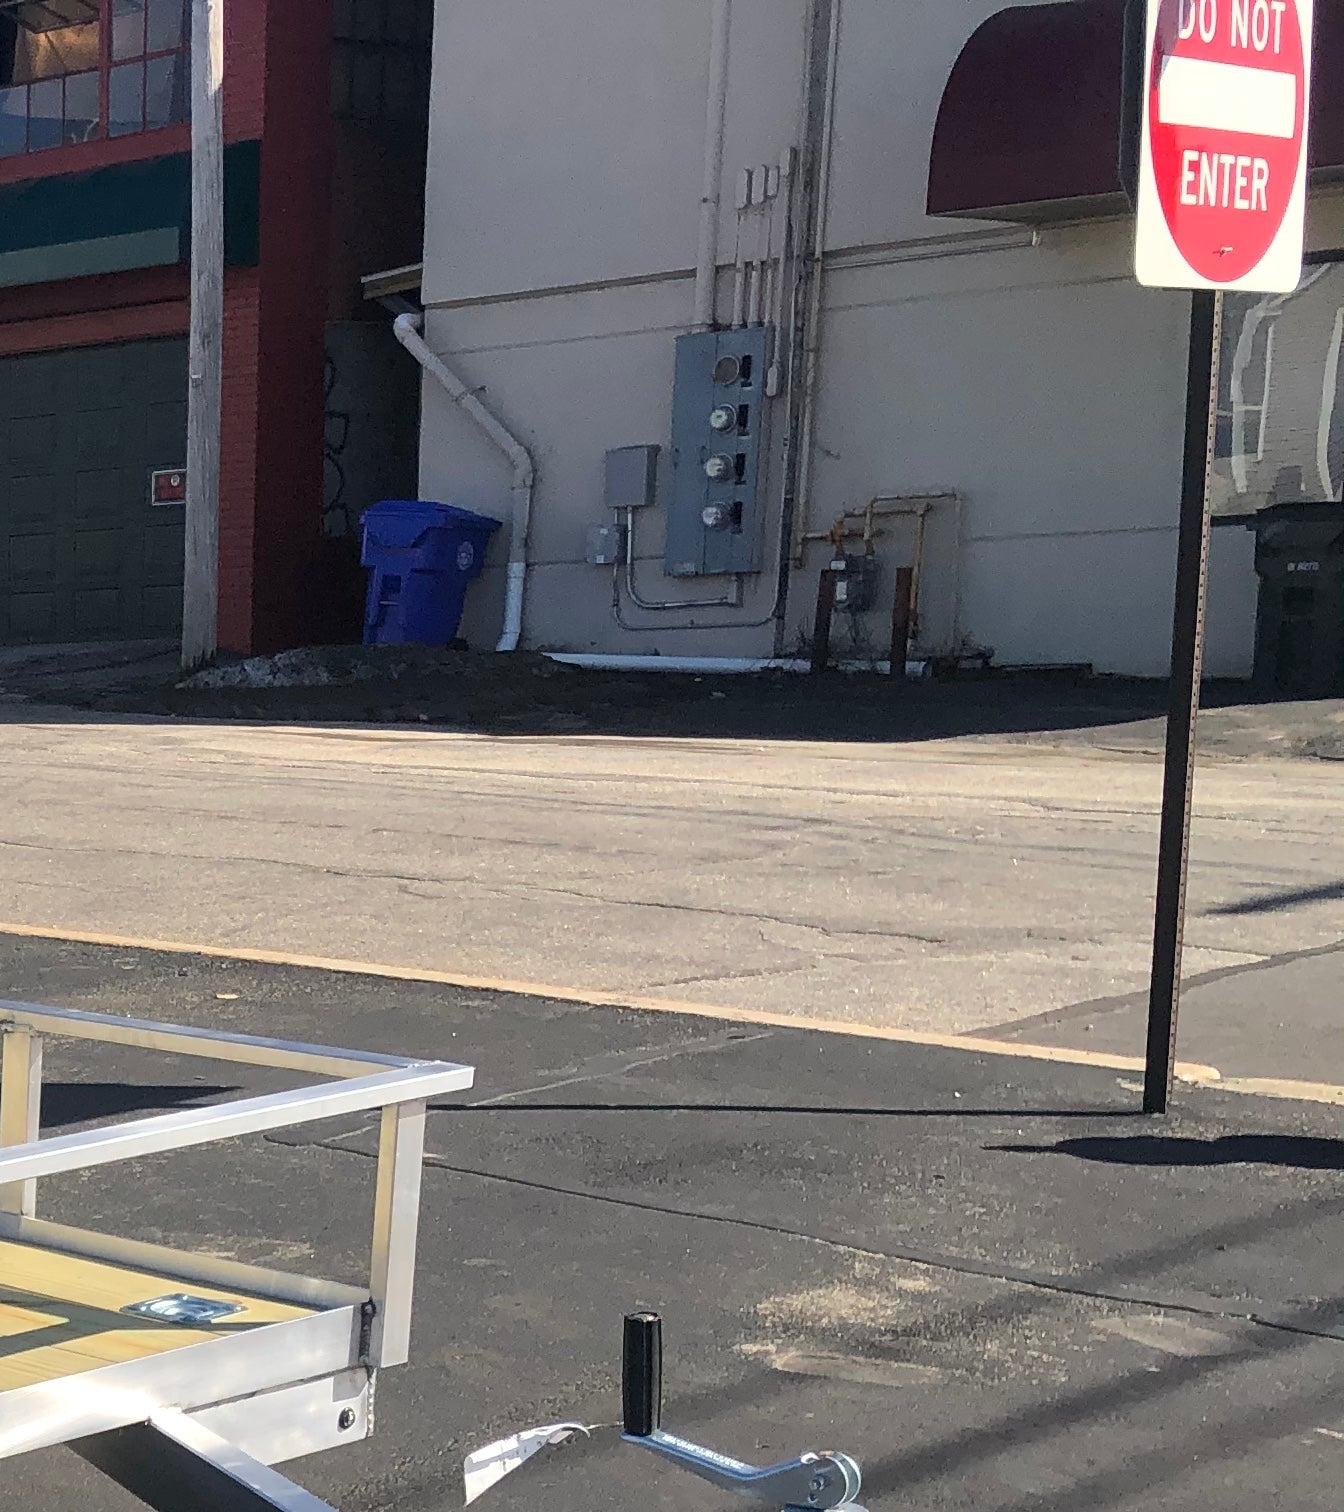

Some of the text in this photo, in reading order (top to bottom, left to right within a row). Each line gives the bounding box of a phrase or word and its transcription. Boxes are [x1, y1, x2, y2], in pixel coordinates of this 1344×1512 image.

[1179, 0, 1286, 54] DO NOT
[1180, 149, 1269, 212] ENTER
